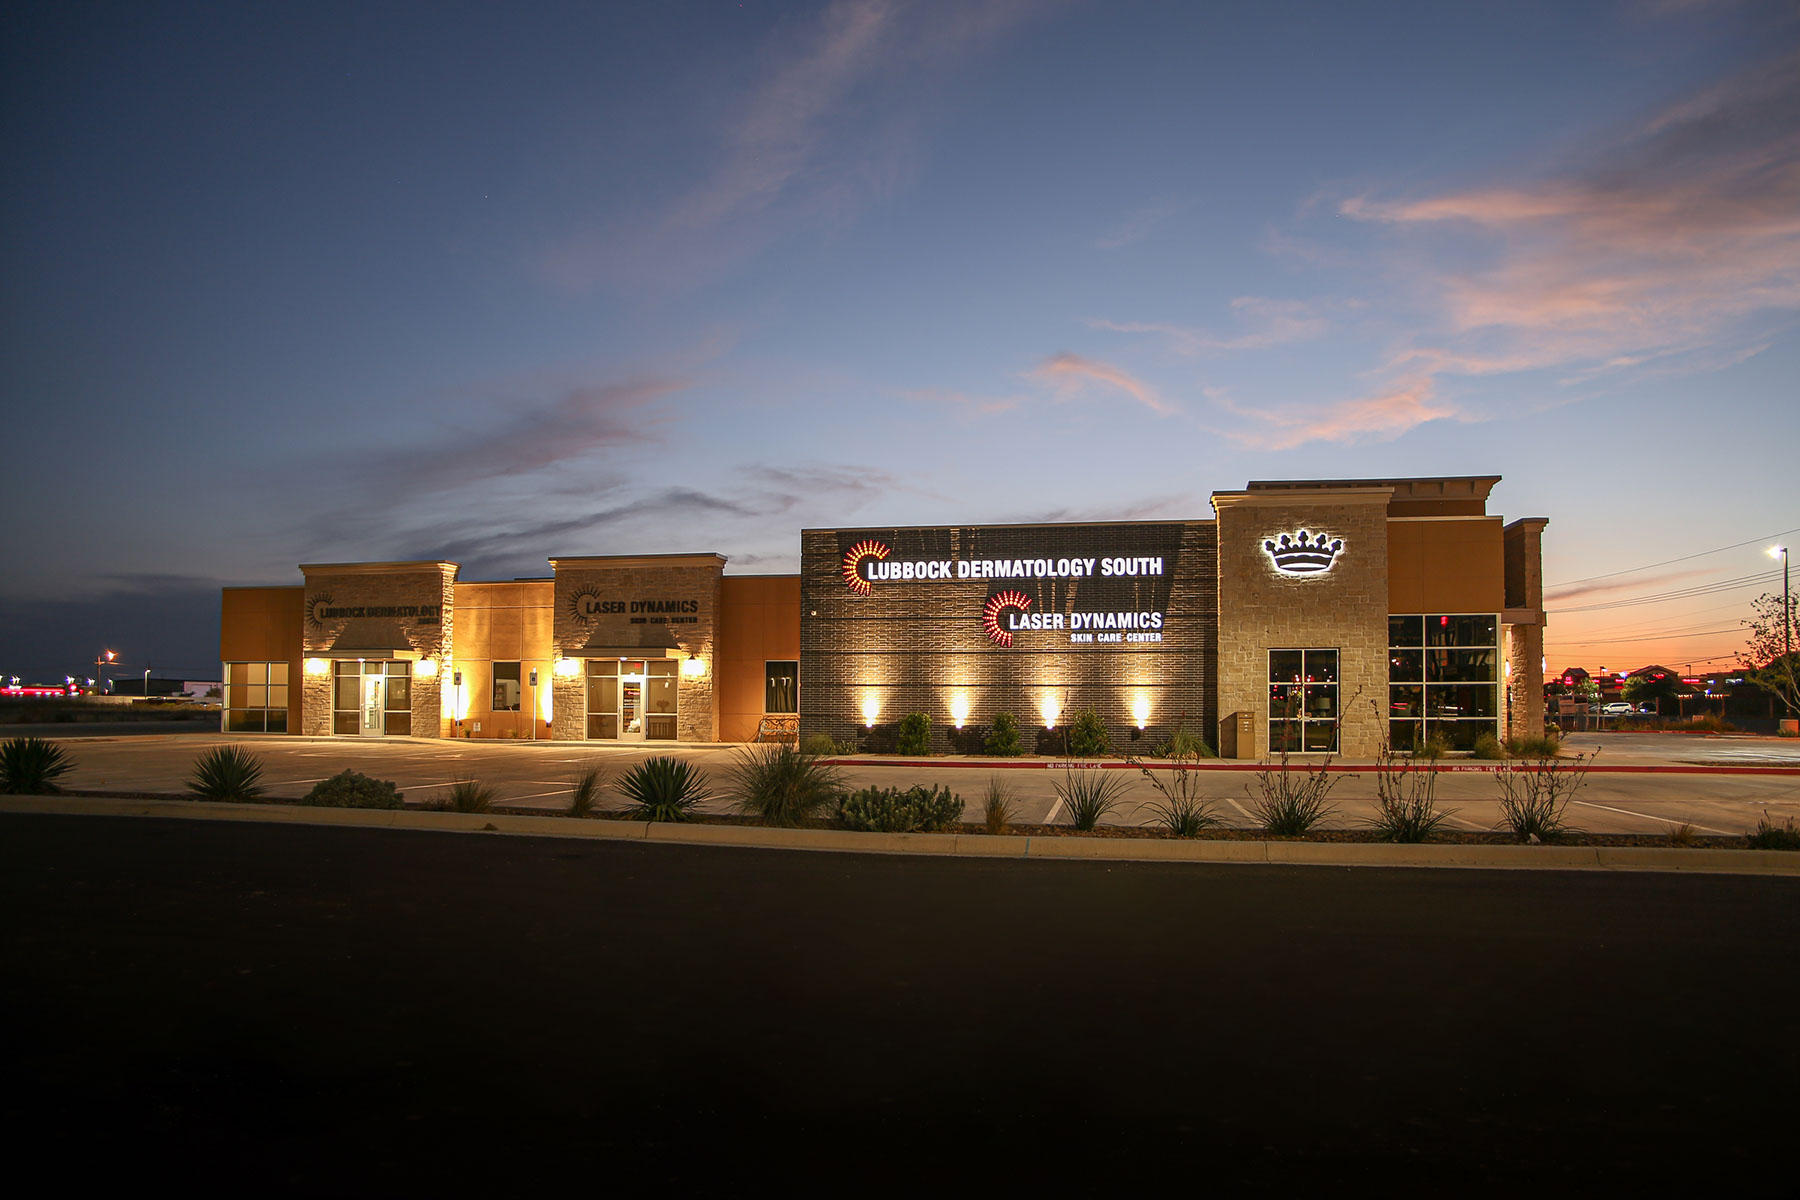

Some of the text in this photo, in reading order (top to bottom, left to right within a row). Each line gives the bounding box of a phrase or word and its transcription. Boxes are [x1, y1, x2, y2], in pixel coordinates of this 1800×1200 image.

[867, 556, 1163, 580] LUBBOCK DERMATOLOGY SOUTH
[586, 600, 698, 614] LASER DYNAMICS
[1009, 611, 1162, 630] LASER DYNAMICS
[1070, 632, 1162, 643] SKIN CARE CENTER
